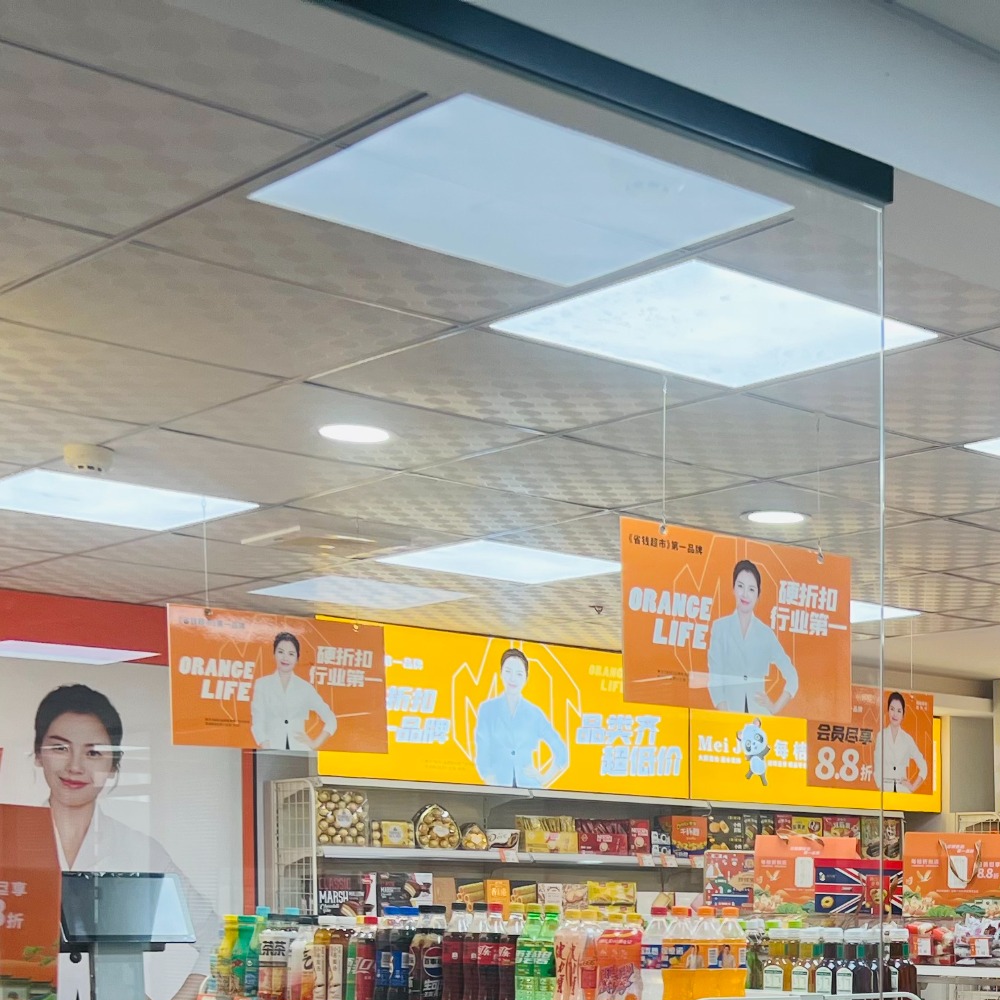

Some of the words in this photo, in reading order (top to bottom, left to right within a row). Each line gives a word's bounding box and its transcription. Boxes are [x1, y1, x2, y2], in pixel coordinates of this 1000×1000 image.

[628, 587, 713, 621] ORANGE
[778, 579, 838, 612] 硬折扣
[652, 618, 710, 650] LIFE
[769, 605, 848, 637] 行业第一
[179, 656, 255, 679] ORANGE
[316, 646, 374, 669] 硬折扣
[201, 679, 252, 702] LIFE
[309, 666, 383, 688] 行业第一
[576, 713, 661, 745] 品类齐
[817, 723, 873, 745] 会员尽享
[698, 734, 729, 753] Mei
[600, 745, 683, 777] 超低价
[815, 746, 873, 782] 8.8折
[319, 891, 348, 904] MARSH
